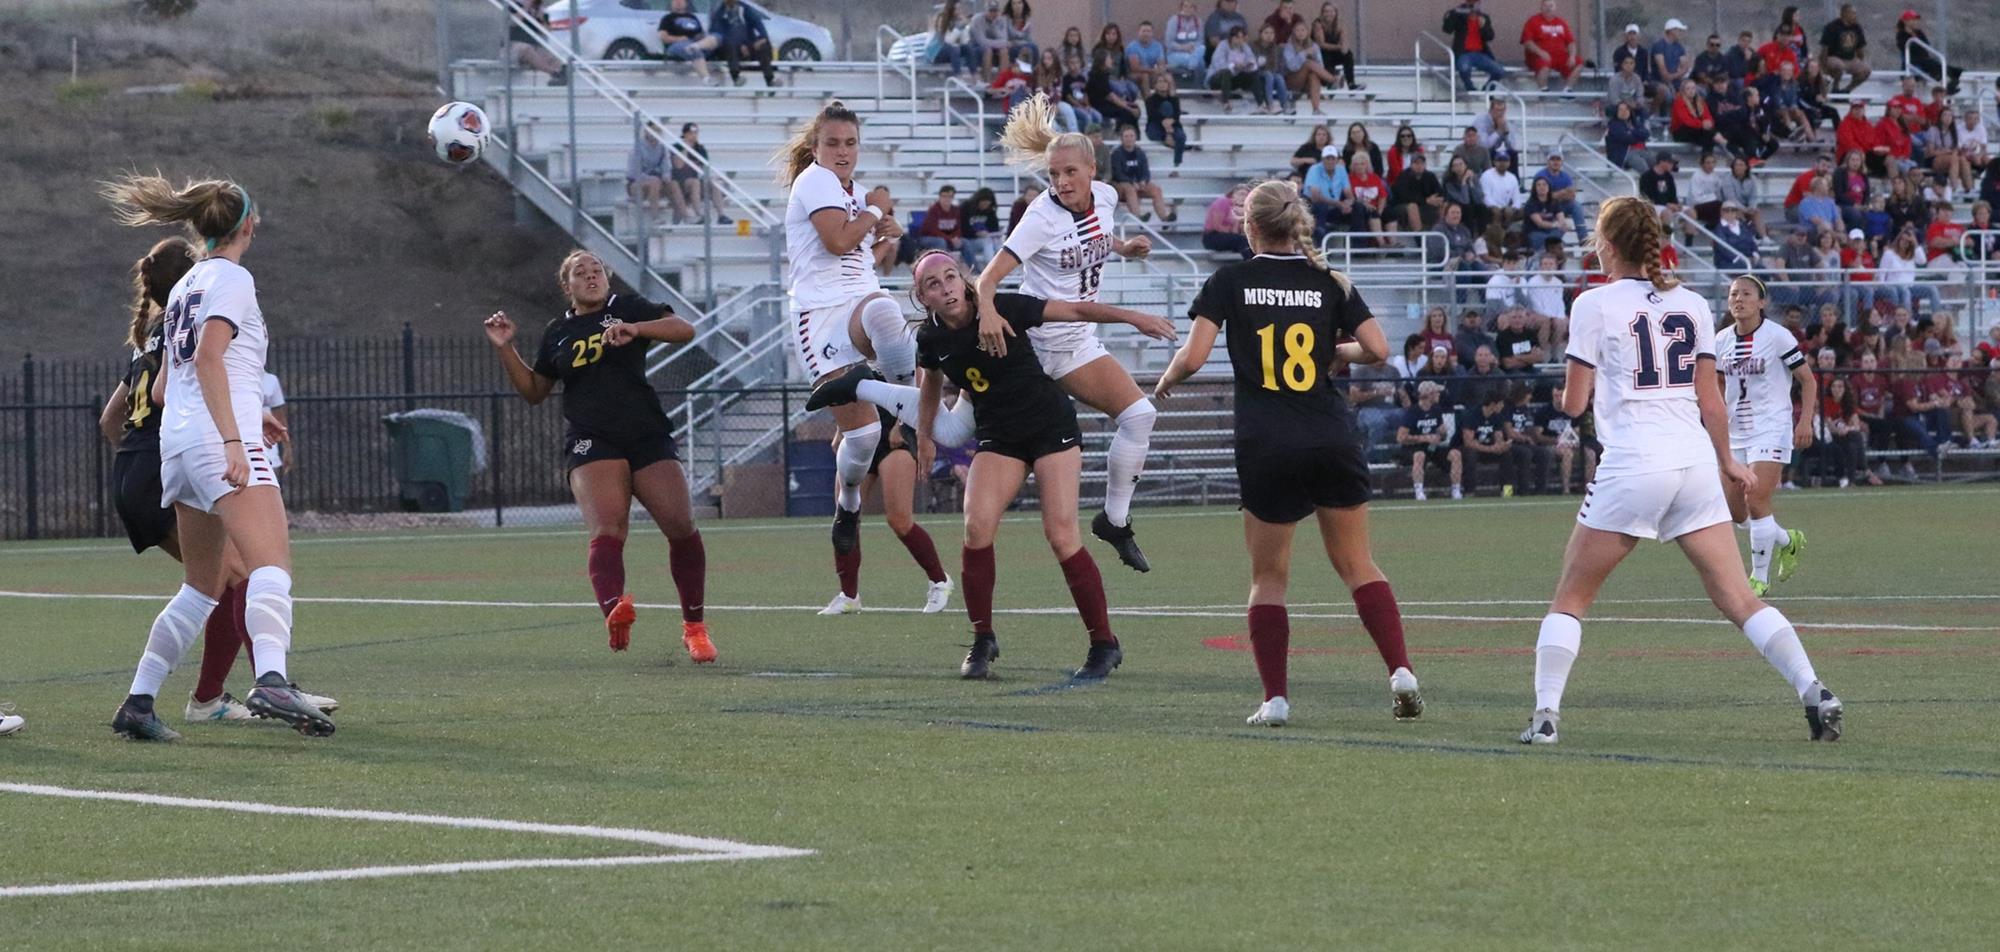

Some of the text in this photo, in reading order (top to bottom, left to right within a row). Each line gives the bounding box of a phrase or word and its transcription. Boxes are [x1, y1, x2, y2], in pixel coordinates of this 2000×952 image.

[1243, 287, 1322, 308] MUSTANGS
[572, 333, 604, 368] 25
[1256, 322, 1317, 392] 18
[1628, 311, 1698, 390] 12
[965, 366, 990, 393] 8
